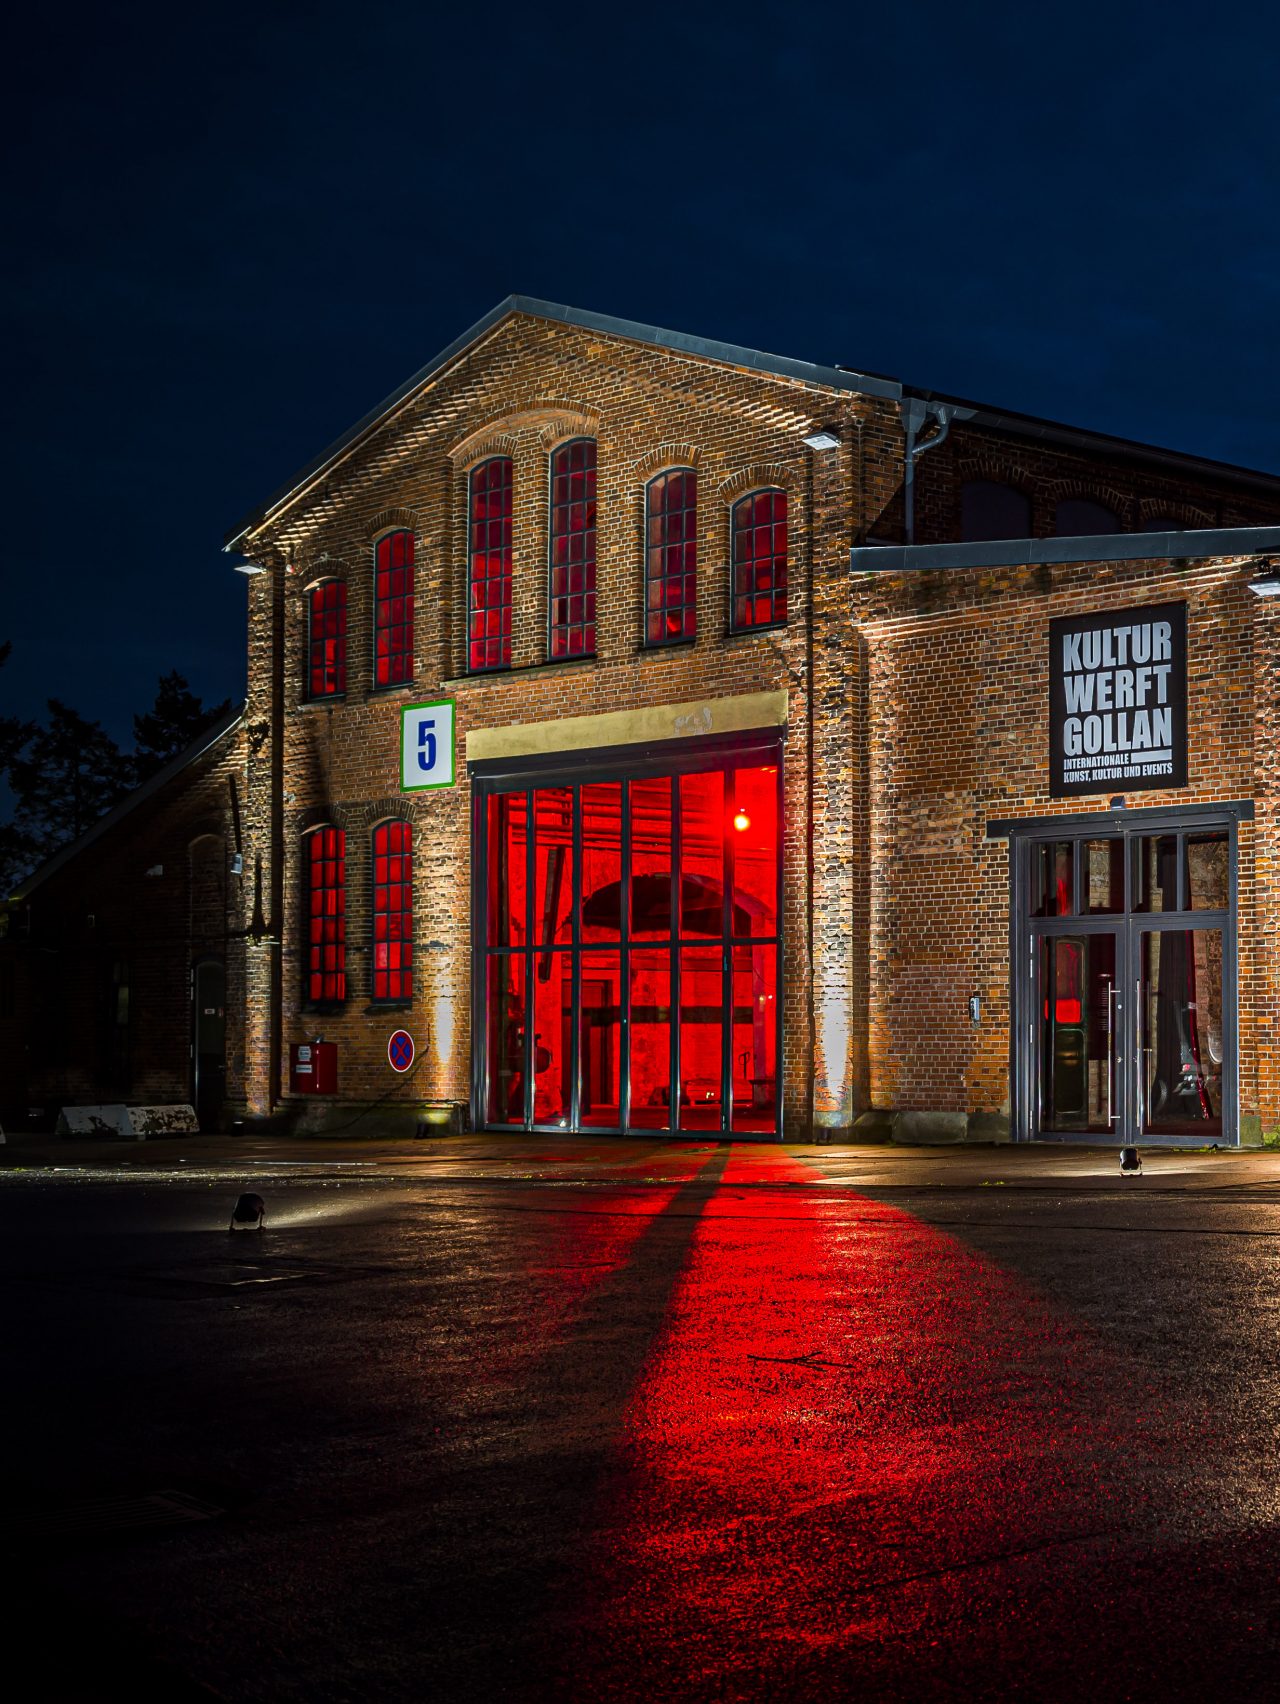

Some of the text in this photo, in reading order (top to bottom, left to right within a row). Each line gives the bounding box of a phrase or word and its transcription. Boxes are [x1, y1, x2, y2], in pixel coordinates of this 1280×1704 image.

[1063, 621, 1172, 673] KULTUR
[1063, 664, 1172, 714] WERFT
[417, 719, 437, 771] 5
[1063, 707, 1173, 757] GOLLAN
[1063, 753, 1129, 770] INTERNATIONALE
[1063, 762, 1173, 783] KUNST, KULTUR UND EVENTS
